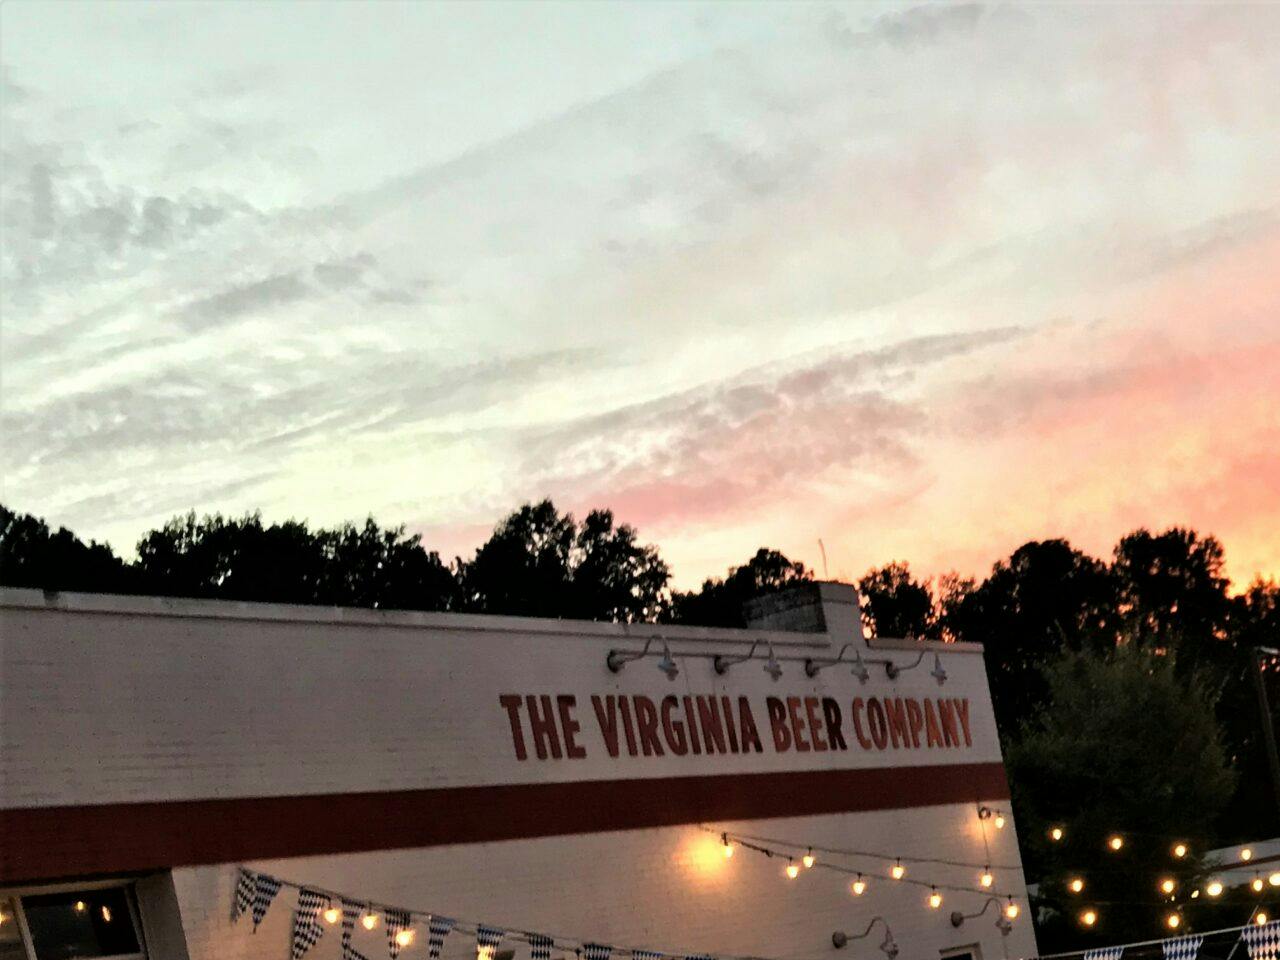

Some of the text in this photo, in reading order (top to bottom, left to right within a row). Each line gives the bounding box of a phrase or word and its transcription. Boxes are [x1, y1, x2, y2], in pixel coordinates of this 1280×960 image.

[500, 694, 973, 761] THE VIRGINIA BEER COMPANY
